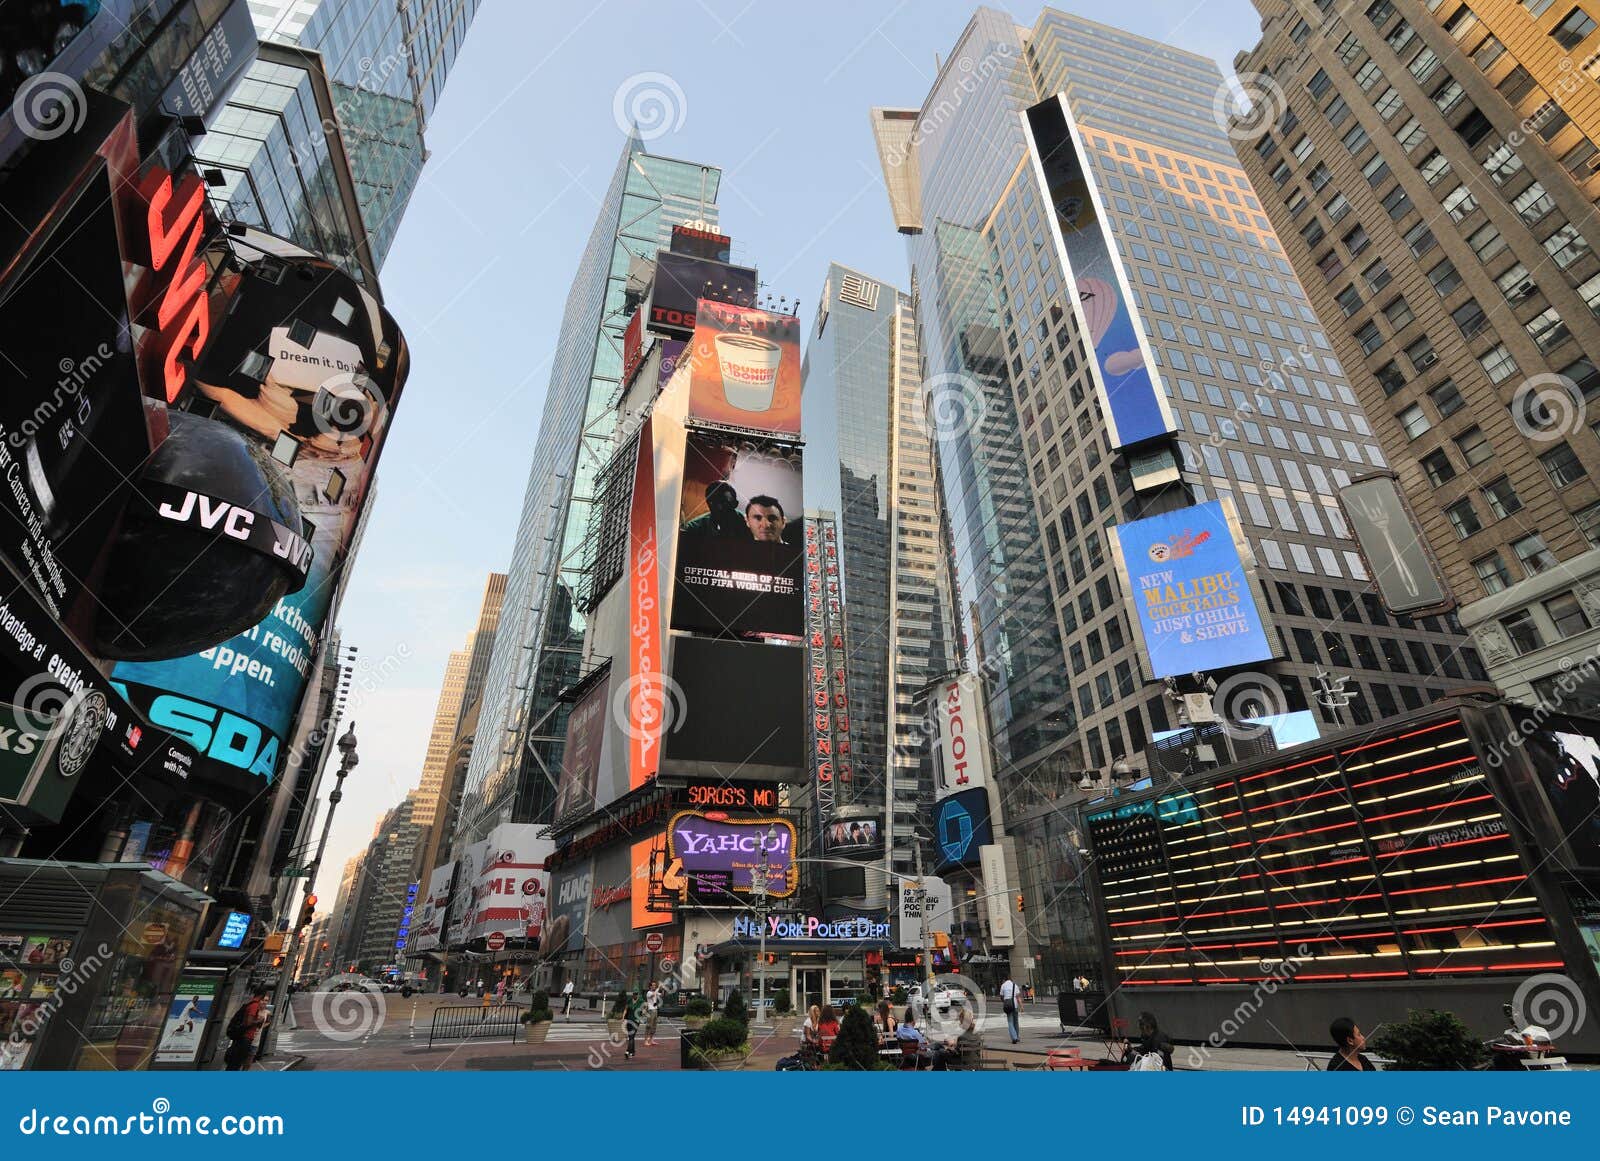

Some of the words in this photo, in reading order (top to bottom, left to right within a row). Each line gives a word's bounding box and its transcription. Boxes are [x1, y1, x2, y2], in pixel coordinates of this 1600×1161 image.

[179, 66, 205, 116] ADIUM
[190, 52, 214, 107] ANKEE
[683, 219, 721, 235] 2010
[652, 307, 696, 327] TOS
[280, 350, 319, 366] Dream
[322, 357, 335, 368] it.
[336, 360, 349, 372] Do
[7, 462, 30, 516] Camera
[27, 515, 43, 542] with
[41, 540, 67, 599] Smartphone
[158, 491, 255, 541] JVC
[272, 532, 314, 575] JVC
[684, 566, 730, 579] OFFICIAL
[731, 571, 758, 582] BEER
[760, 574, 773, 584] OF
[775, 576, 794, 586] THE
[684, 575, 709, 585] 2010
[711, 578, 734, 588] FIFA
[735, 581, 772, 592] WORLD
[1139, 570, 1173, 589] NEW
[1148, 590, 1240, 621] COCKTAILS
[1154, 614, 1192, 635] JUST
[1195, 605, 1245, 626] CHILL
[0, 602, 36, 652] dvantage
[33, 643, 48, 662] at
[272, 597, 317, 649] kthrou
[1180, 631, 1193, 644] &
[1196, 620, 1249, 641] SERVE
[631, 527, 656, 768] Walgreens
[0, 726, 39, 755] KS
[946, 682, 969, 785] RICOH
[688, 786, 746, 805] SOROS'S
[559, 876, 590, 906] HUNG
[768, 916, 805, 937] YORK
[808, 916, 852, 937] POLICE
[856, 917, 891, 937] DEPT
